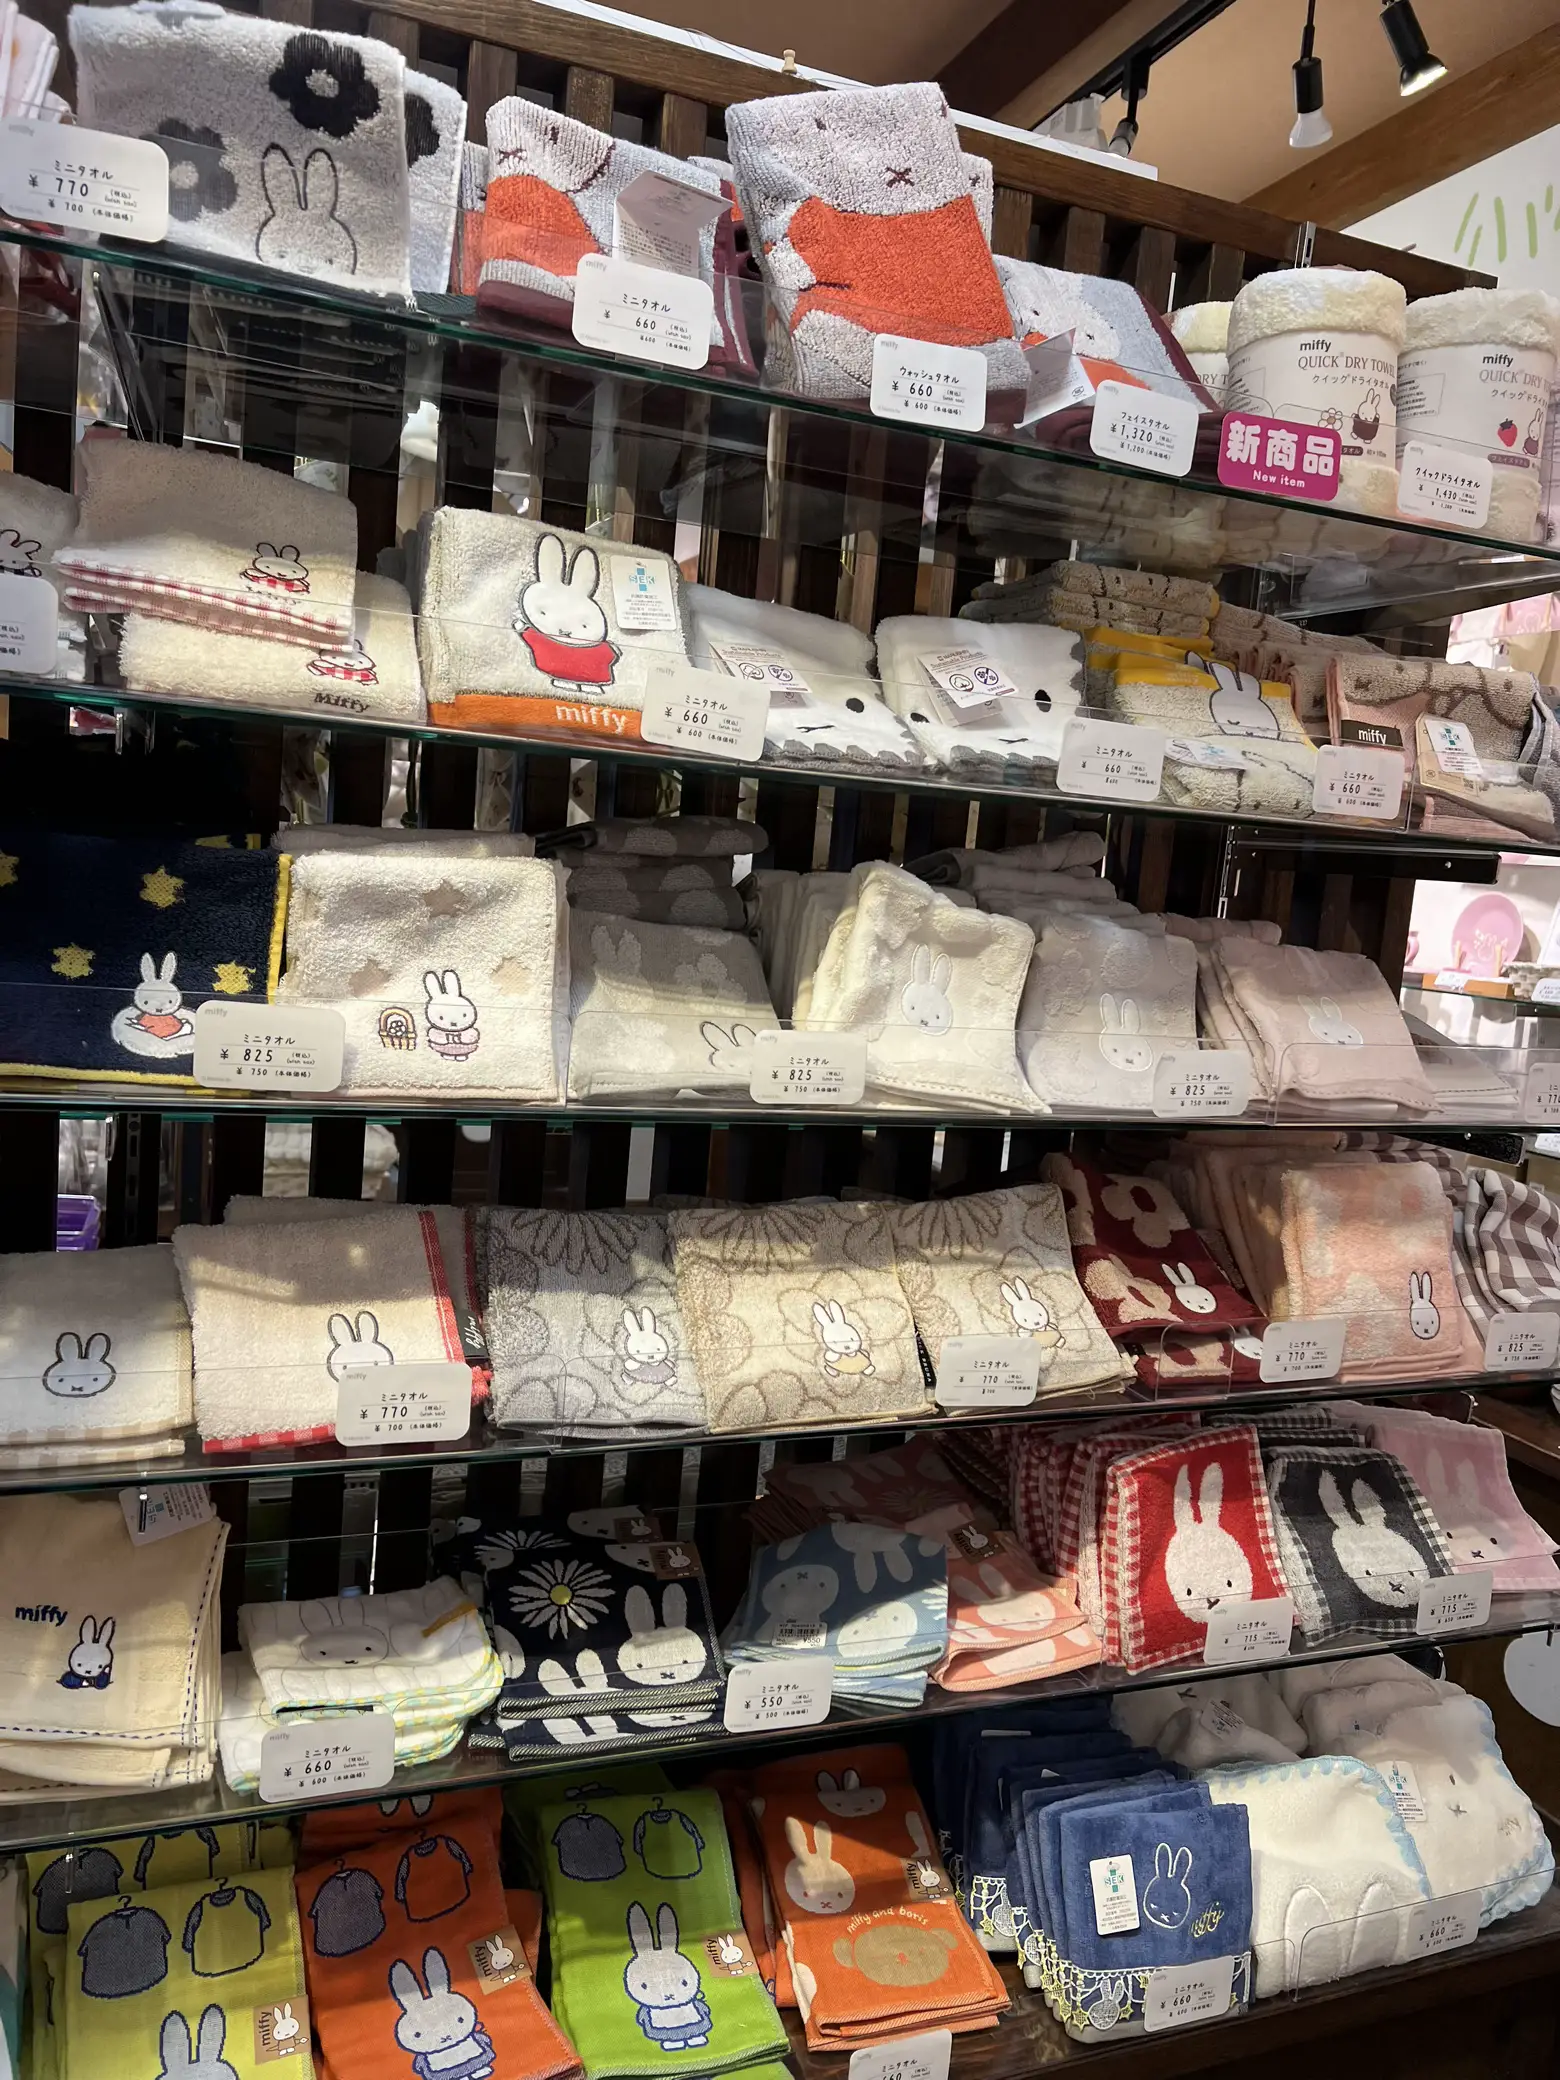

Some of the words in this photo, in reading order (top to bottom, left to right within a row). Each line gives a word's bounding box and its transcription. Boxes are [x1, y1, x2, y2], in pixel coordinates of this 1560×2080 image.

[55, 160, 113, 180] ミニタオル
[29, 174, 38, 188] ¥
[56, 178, 89, 196] 770
[65, 202, 83, 212] 700
[623, 294, 671, 312] ミニタオル
[604, 310, 610, 319] ¥
[636, 317, 656, 330] 660
[1300, 340, 1331, 352] miffy
[1298, 356, 1339, 369] QUICK
[1345, 356, 1369, 369] DRY
[1371, 359, 1395, 378] TOWEL
[1483, 354, 1513, 367] miffy
[900, 366, 959, 383] ウォッシュタオル
[1479, 369, 1519, 383] QUICK
[1523, 372, 1542, 388] DRY
[892, 381, 899, 391] ¥
[910, 383, 932, 397] 660
[915, 402, 928, 410] 600
[1121, 412, 1169, 430] フェイスタオル
[1226, 420, 1334, 476] 新商品
[1253, 470, 1277, 483] New
[1280, 475, 1305, 488] item
[1416, 467, 1480, 488] クイックドライタオル
[1436, 488, 1456, 500] 1,430
[314, 693, 370, 712] Miffy
[685, 695, 727, 710] ミニタオル
[555, 704, 627, 734] miffy
[665, 707, 672, 717] ¥
[684, 710, 708, 724] 660
[688, 729, 702, 737] 600
[1358, 728, 1386, 744] miffy
[1096, 746, 1132, 757] ミニタオル
[1105, 764, 1120, 773] 660
[1344, 771, 1374, 780] ミニタオル
[1343, 783, 1360, 793] 660
[244, 1034, 295, 1045] ミニタオル
[221, 1049, 229, 1060] ¥
[244, 1049, 273, 1062] 825
[790, 1057, 829, 1065] ミニタオル
[251, 1068, 268, 1076] 750
[772, 1070, 778, 1079] ¥
[790, 1070, 812, 1080] 825
[1170, 1087, 1176, 1095] ¥
[1186, 1085, 1205, 1095] 825
[1509, 1343, 1523, 1352] 825
[1289, 1352, 1305, 1361] 770
[382, 1393, 427, 1402] ミニタオル
[360, 1409, 368, 1419] ¥
[382, 1406, 407, 1418] 770
[1442, 1604, 1456, 1614] 715
[16, 1605, 68, 1627] miffy
[1237, 1621, 1267, 1630] ミニタオル
[762, 1684, 799, 1693] ミニタオル
[745, 1701, 750, 1709] ¥
[761, 1697, 782, 1707] 550
[305, 1746, 351, 1758] ミニタオル
[284, 1768, 291, 1776] ¥
[305, 1760, 331, 1774] 660
[907, 1863, 920, 1889] miffy
[872, 1907, 894, 1918] and
[899, 1906, 929, 1925] boris
[1430, 1927, 1445, 1938] 660
[707, 1939, 721, 1964] miffy
[475, 1946, 492, 1976] miffy
[1173, 1995, 1191, 2006] 660
[259, 2012, 271, 2046] miffy
[882, 2059, 917, 2072] ミニタオル
